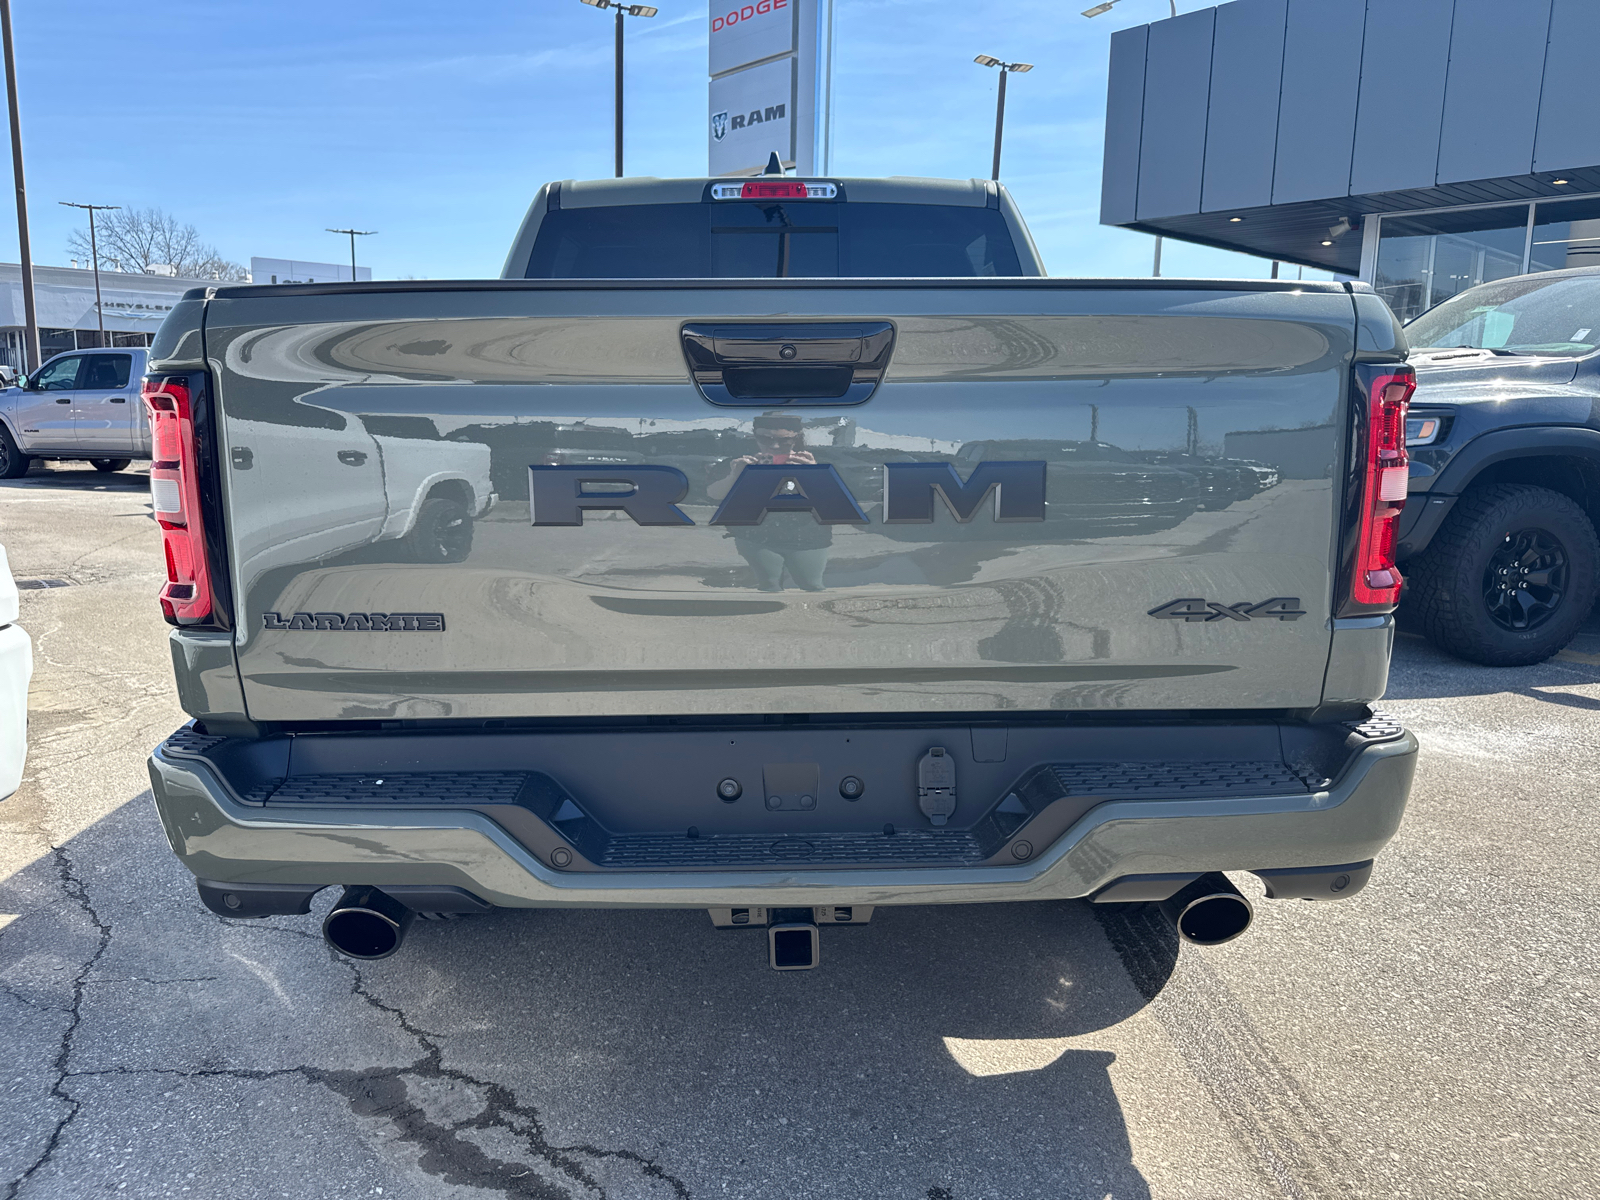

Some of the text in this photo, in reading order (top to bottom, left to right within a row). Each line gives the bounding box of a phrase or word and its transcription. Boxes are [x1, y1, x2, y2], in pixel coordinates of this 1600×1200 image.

[712, 0, 787, 33] DODGE
[731, 104, 785, 130] RAM
[528, 461, 1047, 527] RAM
[262, 612, 446, 632] LARAMIE
